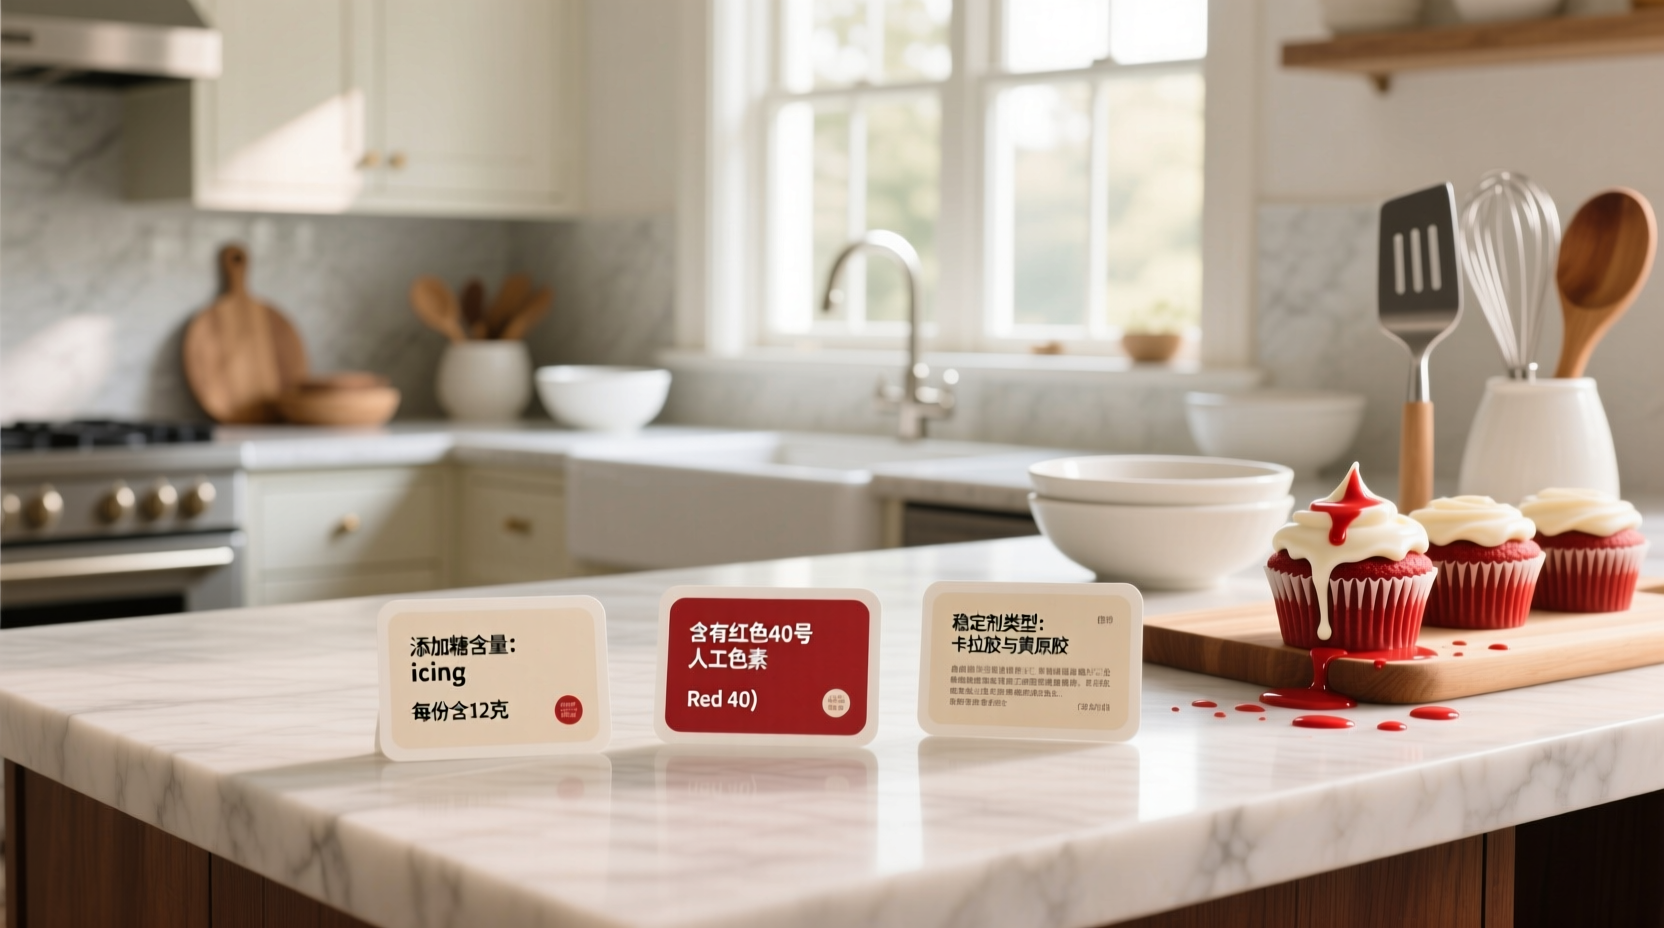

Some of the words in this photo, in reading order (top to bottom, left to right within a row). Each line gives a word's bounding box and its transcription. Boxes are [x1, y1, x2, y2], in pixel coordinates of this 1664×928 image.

[689, 621, 813, 645] 含有红色40号
[410, 634, 516, 657] 添加糖含量：
[688, 647, 769, 671] 人工色素
[411, 661, 466, 687] icing
[411, 699, 509, 722] 每份含12克
[687, 689, 723, 708] Red
[727, 689, 758, 712] 40)
